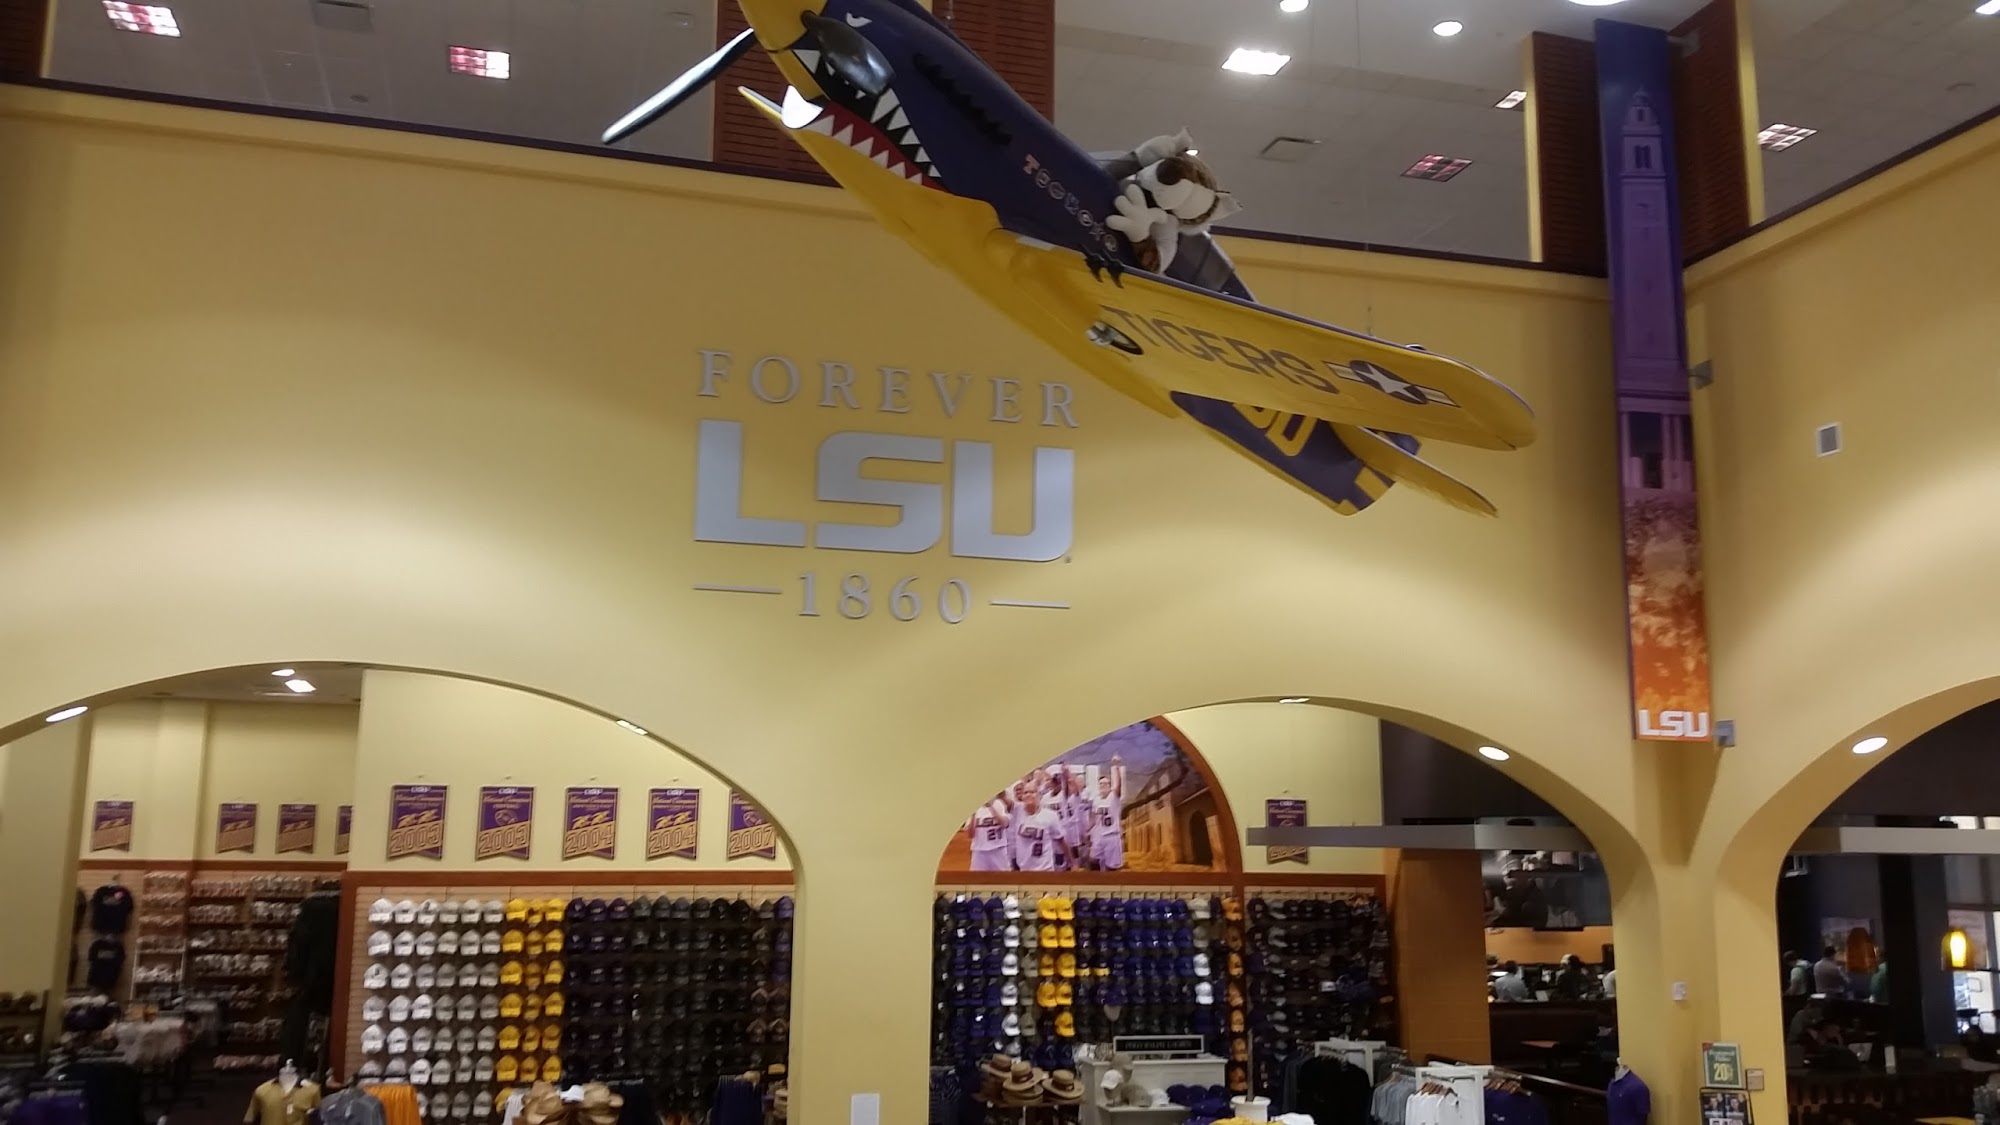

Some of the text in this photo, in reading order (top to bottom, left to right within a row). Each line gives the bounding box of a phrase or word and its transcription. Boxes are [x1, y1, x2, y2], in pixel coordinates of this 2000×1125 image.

[1101, 303, 1340, 395] TIGERS
[697, 350, 1080, 428] FOREVER
[693, 418, 1075, 562] LSU
[798, 571, 973, 624] 1860
[1638, 709, 1709, 738] LSU
[389, 823, 440, 853] 2003
[479, 823, 528, 854] 2003
[565, 823, 614, 854] 2004
[649, 823, 695, 854] 2004
[729, 823, 774, 854] 2007
[1018, 824, 1045, 841] LSU
